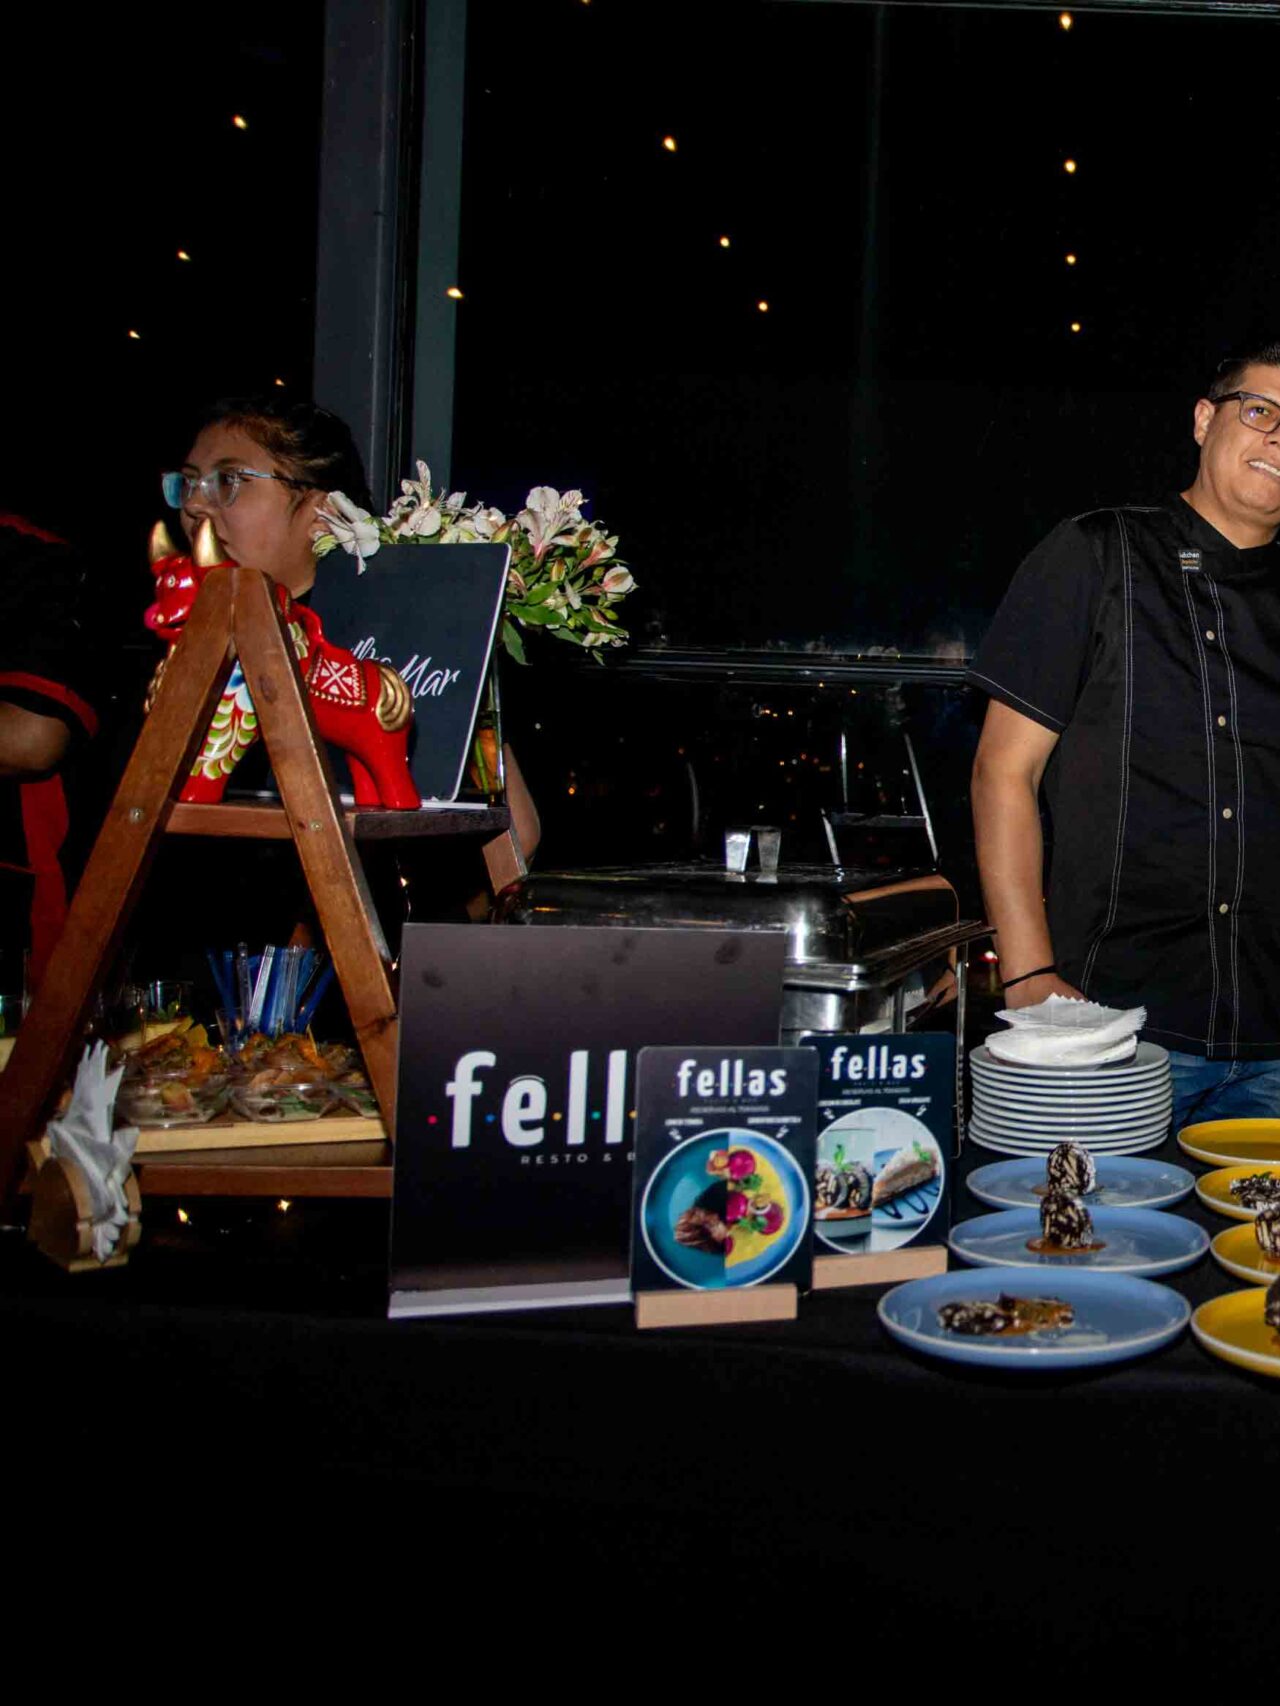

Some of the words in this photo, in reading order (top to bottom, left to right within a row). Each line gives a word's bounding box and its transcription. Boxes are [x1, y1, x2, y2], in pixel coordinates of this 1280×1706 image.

[677, 1058, 788, 1098] fellas
[830, 1045, 926, 1081] fellas
[445, 1050, 628, 1149] fell
[520, 1152, 588, 1165] RESTO
